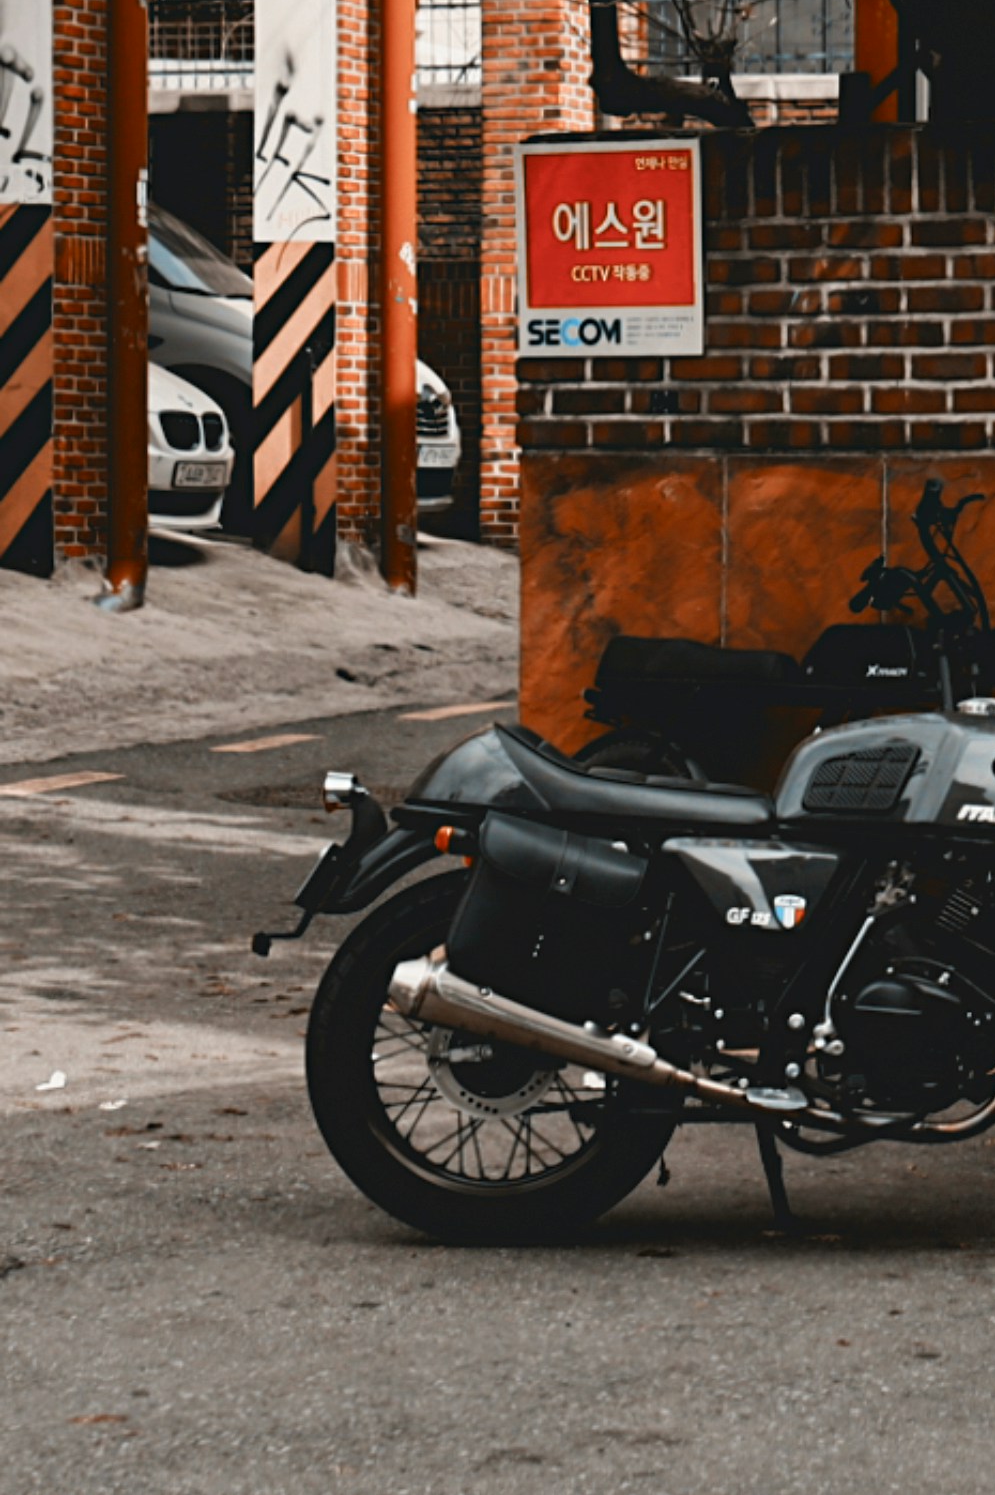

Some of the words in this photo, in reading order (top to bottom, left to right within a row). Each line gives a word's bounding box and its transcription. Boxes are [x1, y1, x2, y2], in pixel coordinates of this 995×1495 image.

[635, 156, 665, 170] 언제나
[553, 199, 665, 251] 에스원
[571, 265, 610, 282] CCTV
[612, 263, 651, 282] 작동중
[528, 318, 621, 346] SECOM
[727, 907, 751, 925] GF
